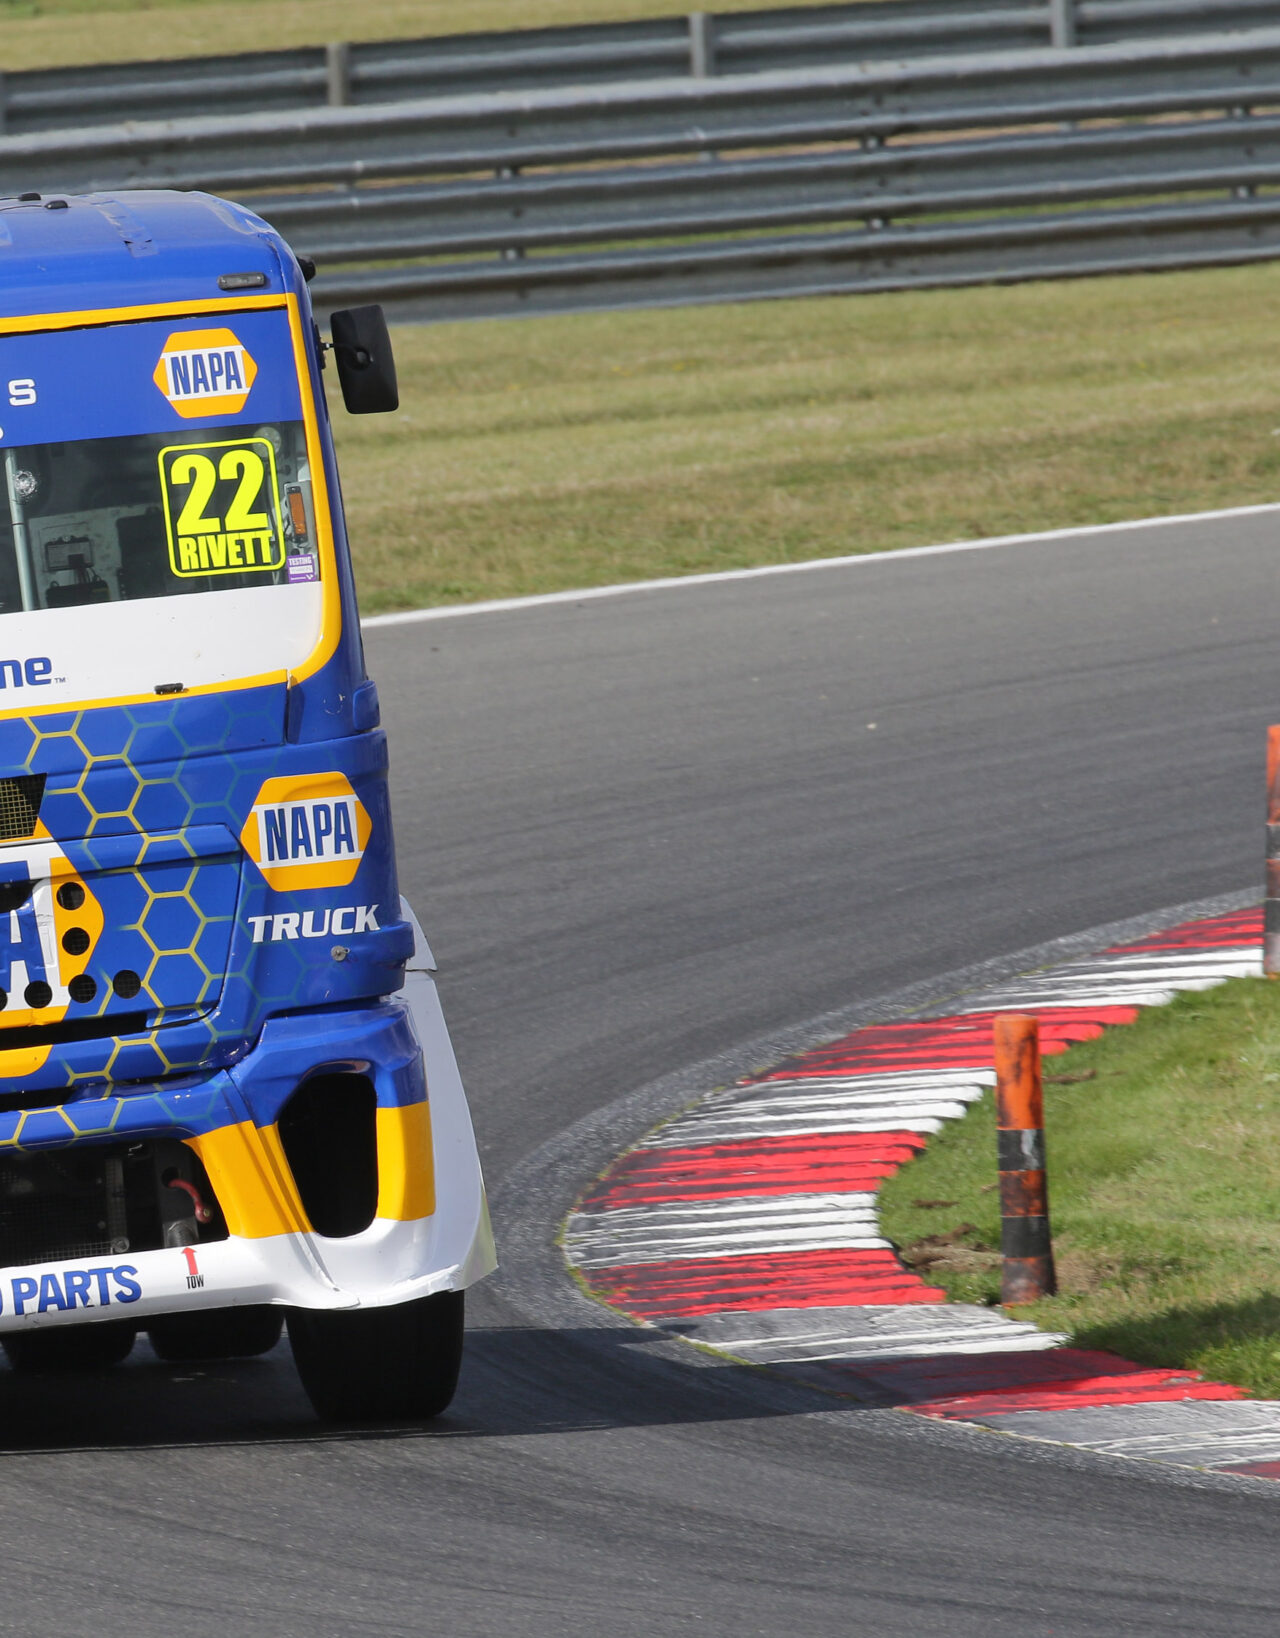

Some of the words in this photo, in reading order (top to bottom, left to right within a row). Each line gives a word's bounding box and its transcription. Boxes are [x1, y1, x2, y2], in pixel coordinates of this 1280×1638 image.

[170, 351, 242, 395] NAPA
[170, 449, 269, 536] 22
[178, 530, 273, 570] RIVETT
[264, 801, 355, 861] NAPA
[247, 904, 381, 943] TRUCK
[11, 1264, 143, 1315] PARTS
[185, 1274, 205, 1290] TOW
